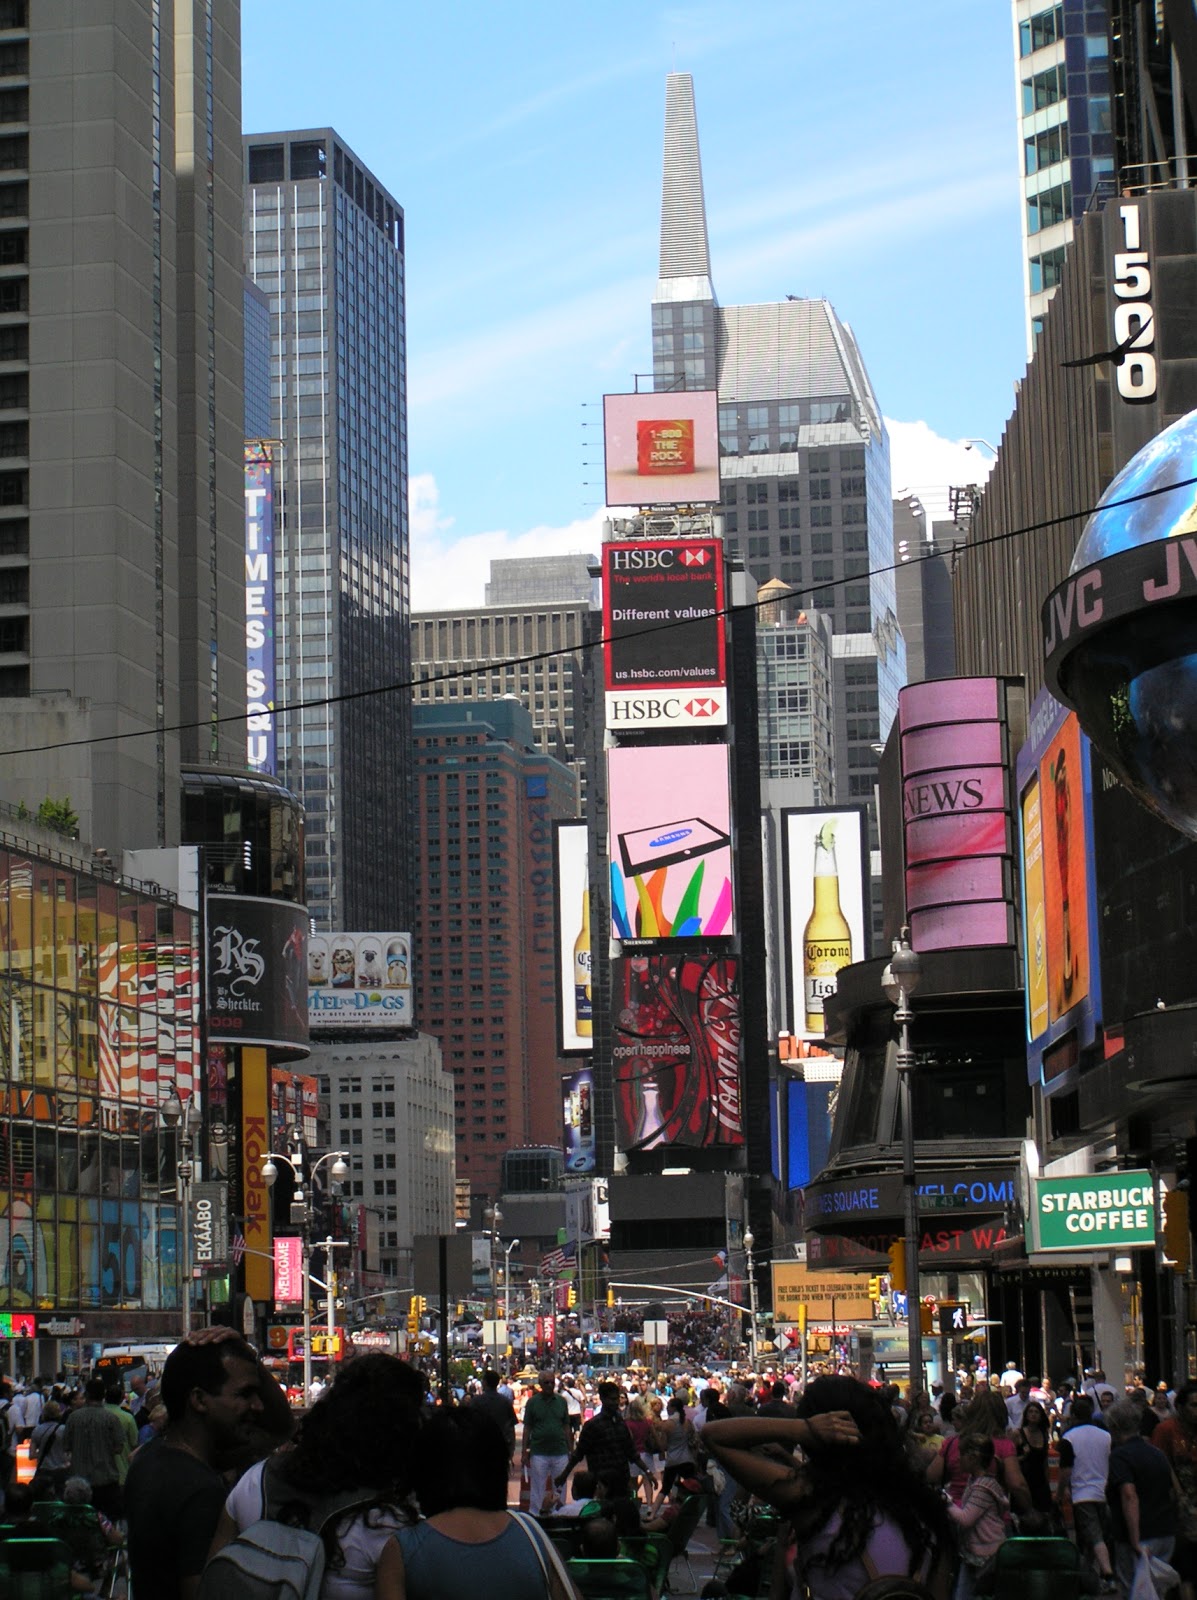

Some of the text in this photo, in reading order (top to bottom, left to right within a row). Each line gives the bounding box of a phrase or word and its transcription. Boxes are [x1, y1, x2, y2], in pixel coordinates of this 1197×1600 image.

[1114, 205, 1156, 399] 1500
[650, 451, 682, 461] ROCK
[654, 441, 678, 450] THE
[245, 488, 268, 649] TIMES
[613, 549, 674, 570] HSBC
[614, 574, 630, 583] The
[632, 573, 665, 583] world's
[667, 572, 688, 581] local
[1045, 538, 1197, 658] JVC JV
[612, 606, 716, 621] Different values
[615, 666, 716, 679] us.hsbc.com/values
[612, 698, 681, 720] HSBC
[906, 779, 983, 816] NEWS
[806, 945, 850, 961] Corona
[810, 978, 838, 998] Lig
[308, 989, 343, 1010] OTEL
[613, 1043, 691, 1057] open happiness
[246, 1116, 268, 1234] Kodak
[834, 1188, 880, 1212] SQUARE
[1041, 1187, 1154, 1213] STARBUCK
[1066, 1209, 1148, 1232] COFFEE
[919, 1229, 964, 1252] AST
[277, 1241, 290, 1298] WELCOME
[1028, 1269, 1085, 1278] SEPHORA
[805, 1284, 819, 1292] TICKET
